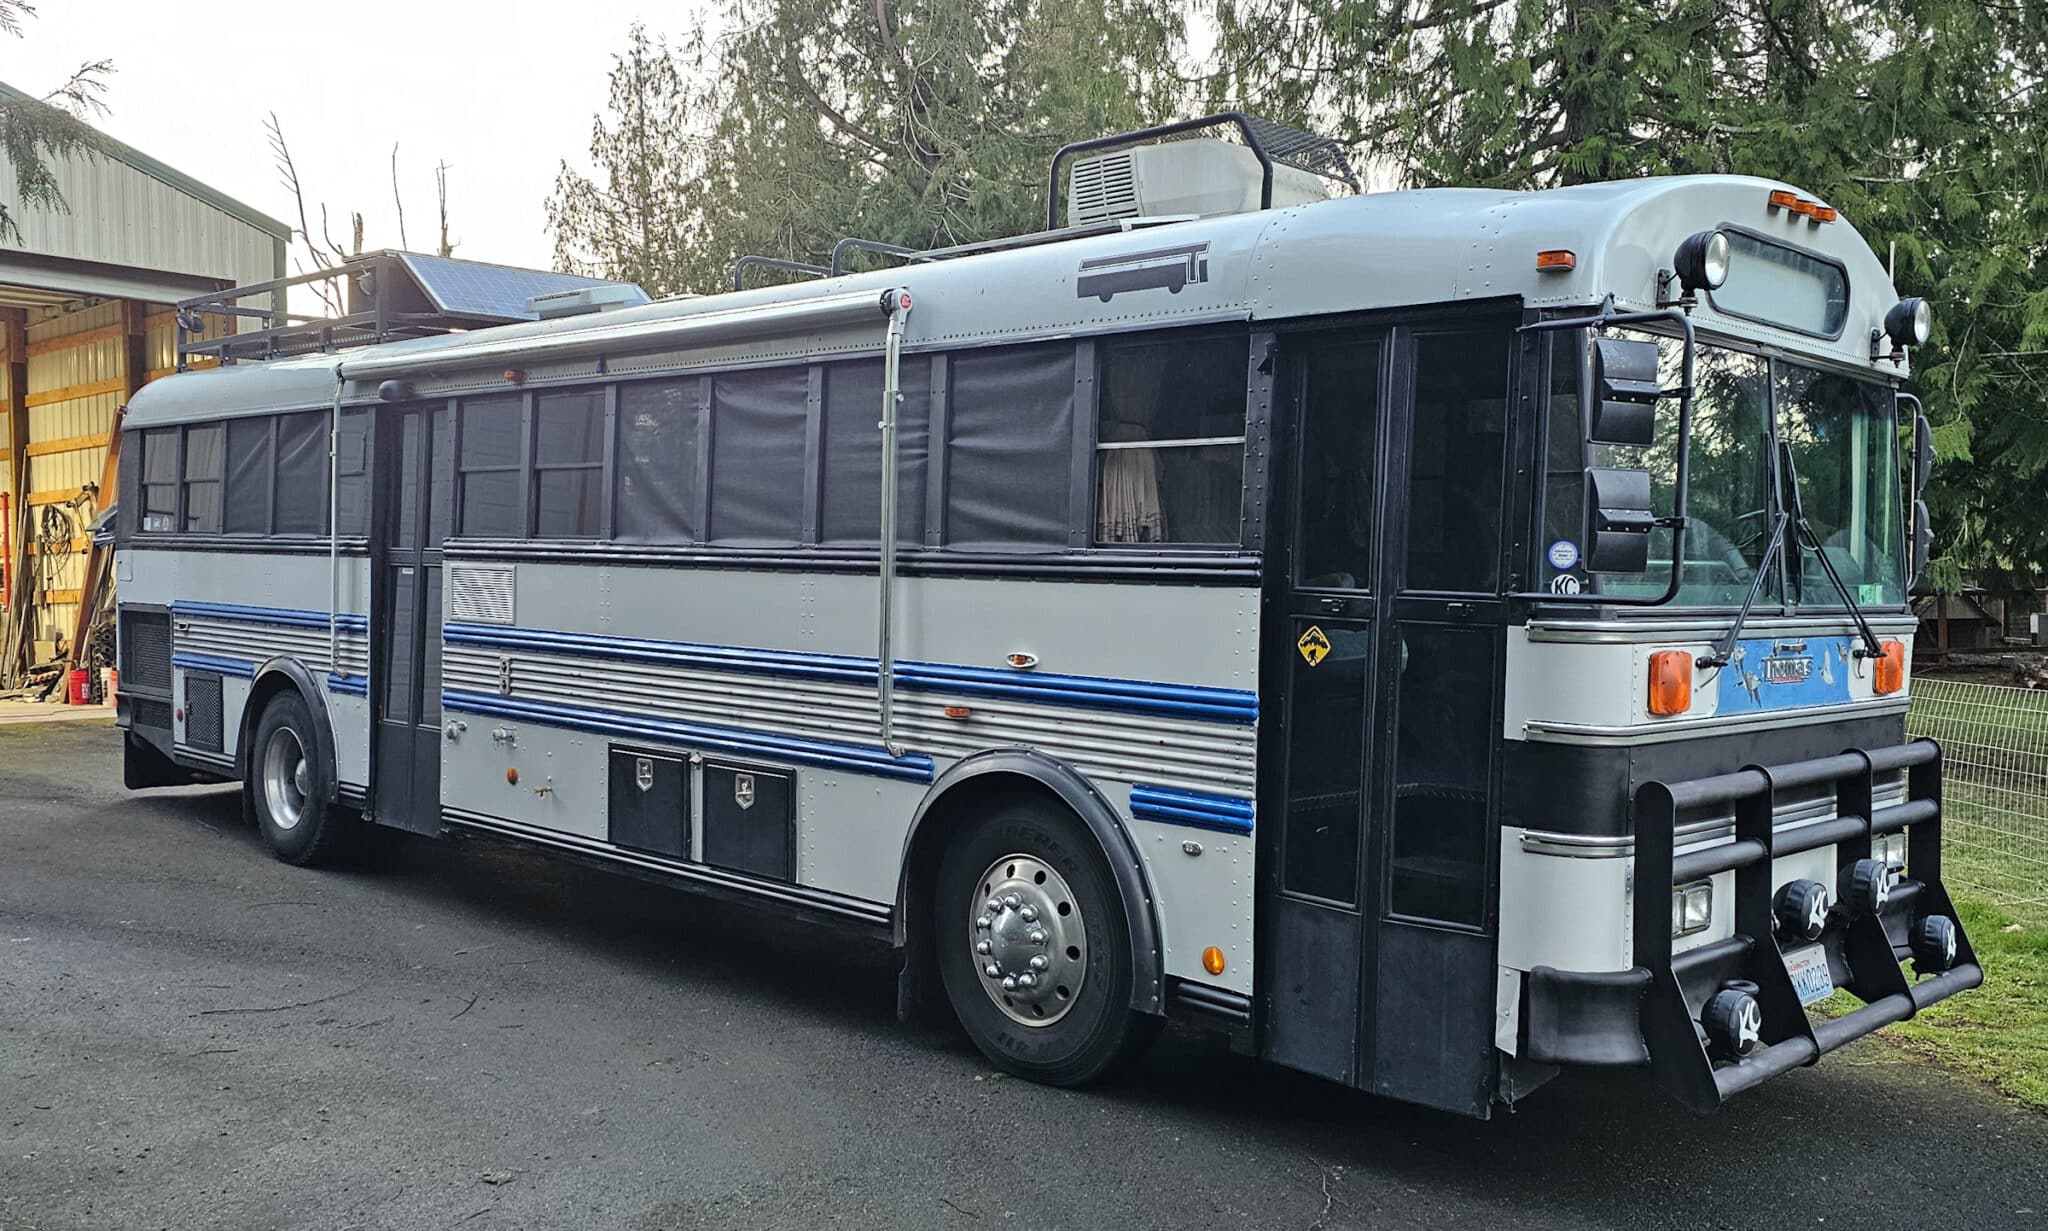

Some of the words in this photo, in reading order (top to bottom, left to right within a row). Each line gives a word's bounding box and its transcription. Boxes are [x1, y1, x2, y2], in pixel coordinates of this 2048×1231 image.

[1555, 576, 1577, 595] KC
[1762, 657, 1813, 682] Thomas
[1739, 1000, 1761, 1048] KC
